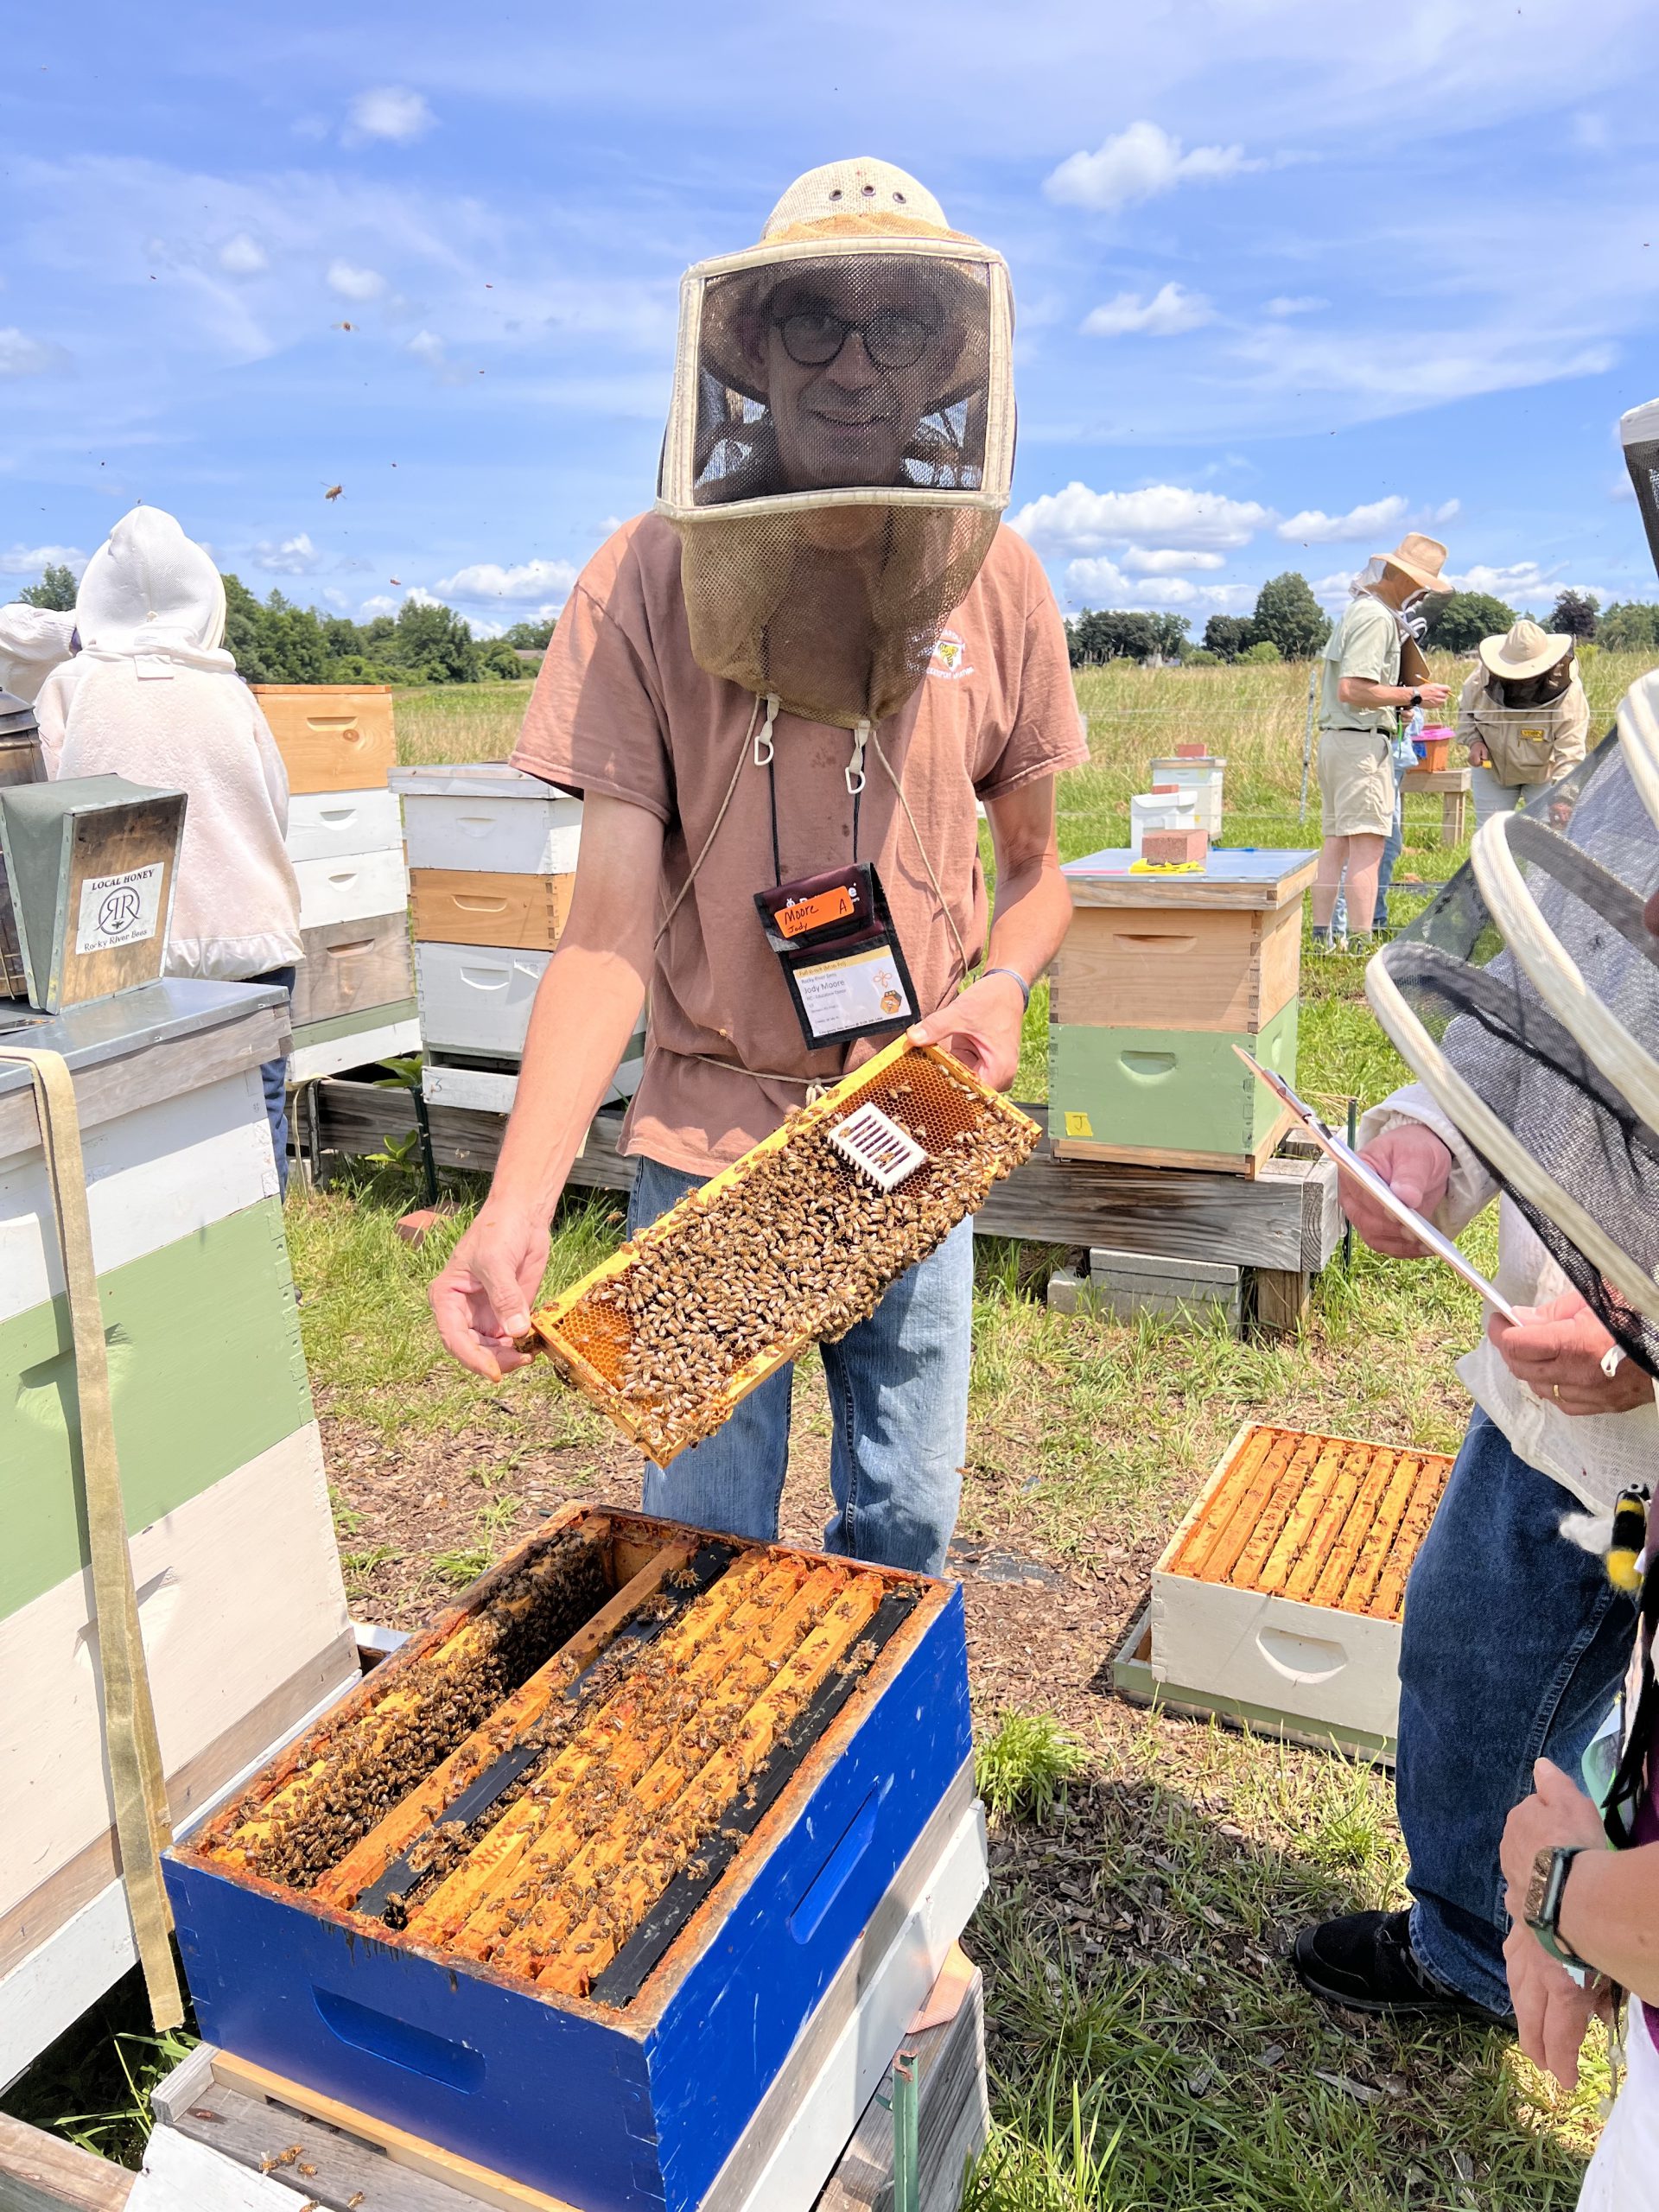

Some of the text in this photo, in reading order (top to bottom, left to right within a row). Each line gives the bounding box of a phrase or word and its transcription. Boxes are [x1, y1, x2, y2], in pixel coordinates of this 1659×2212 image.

[92, 869, 156, 891] LOCAL HONEY
[785, 899, 847, 925] Moore A
[788, 923, 808, 933] Jody
[84, 940, 107, 951] Rocky
[109, 934, 130, 944] River
[804, 980, 845, 994] Jody Moore
[1072, 1115, 1088, 1132] J
